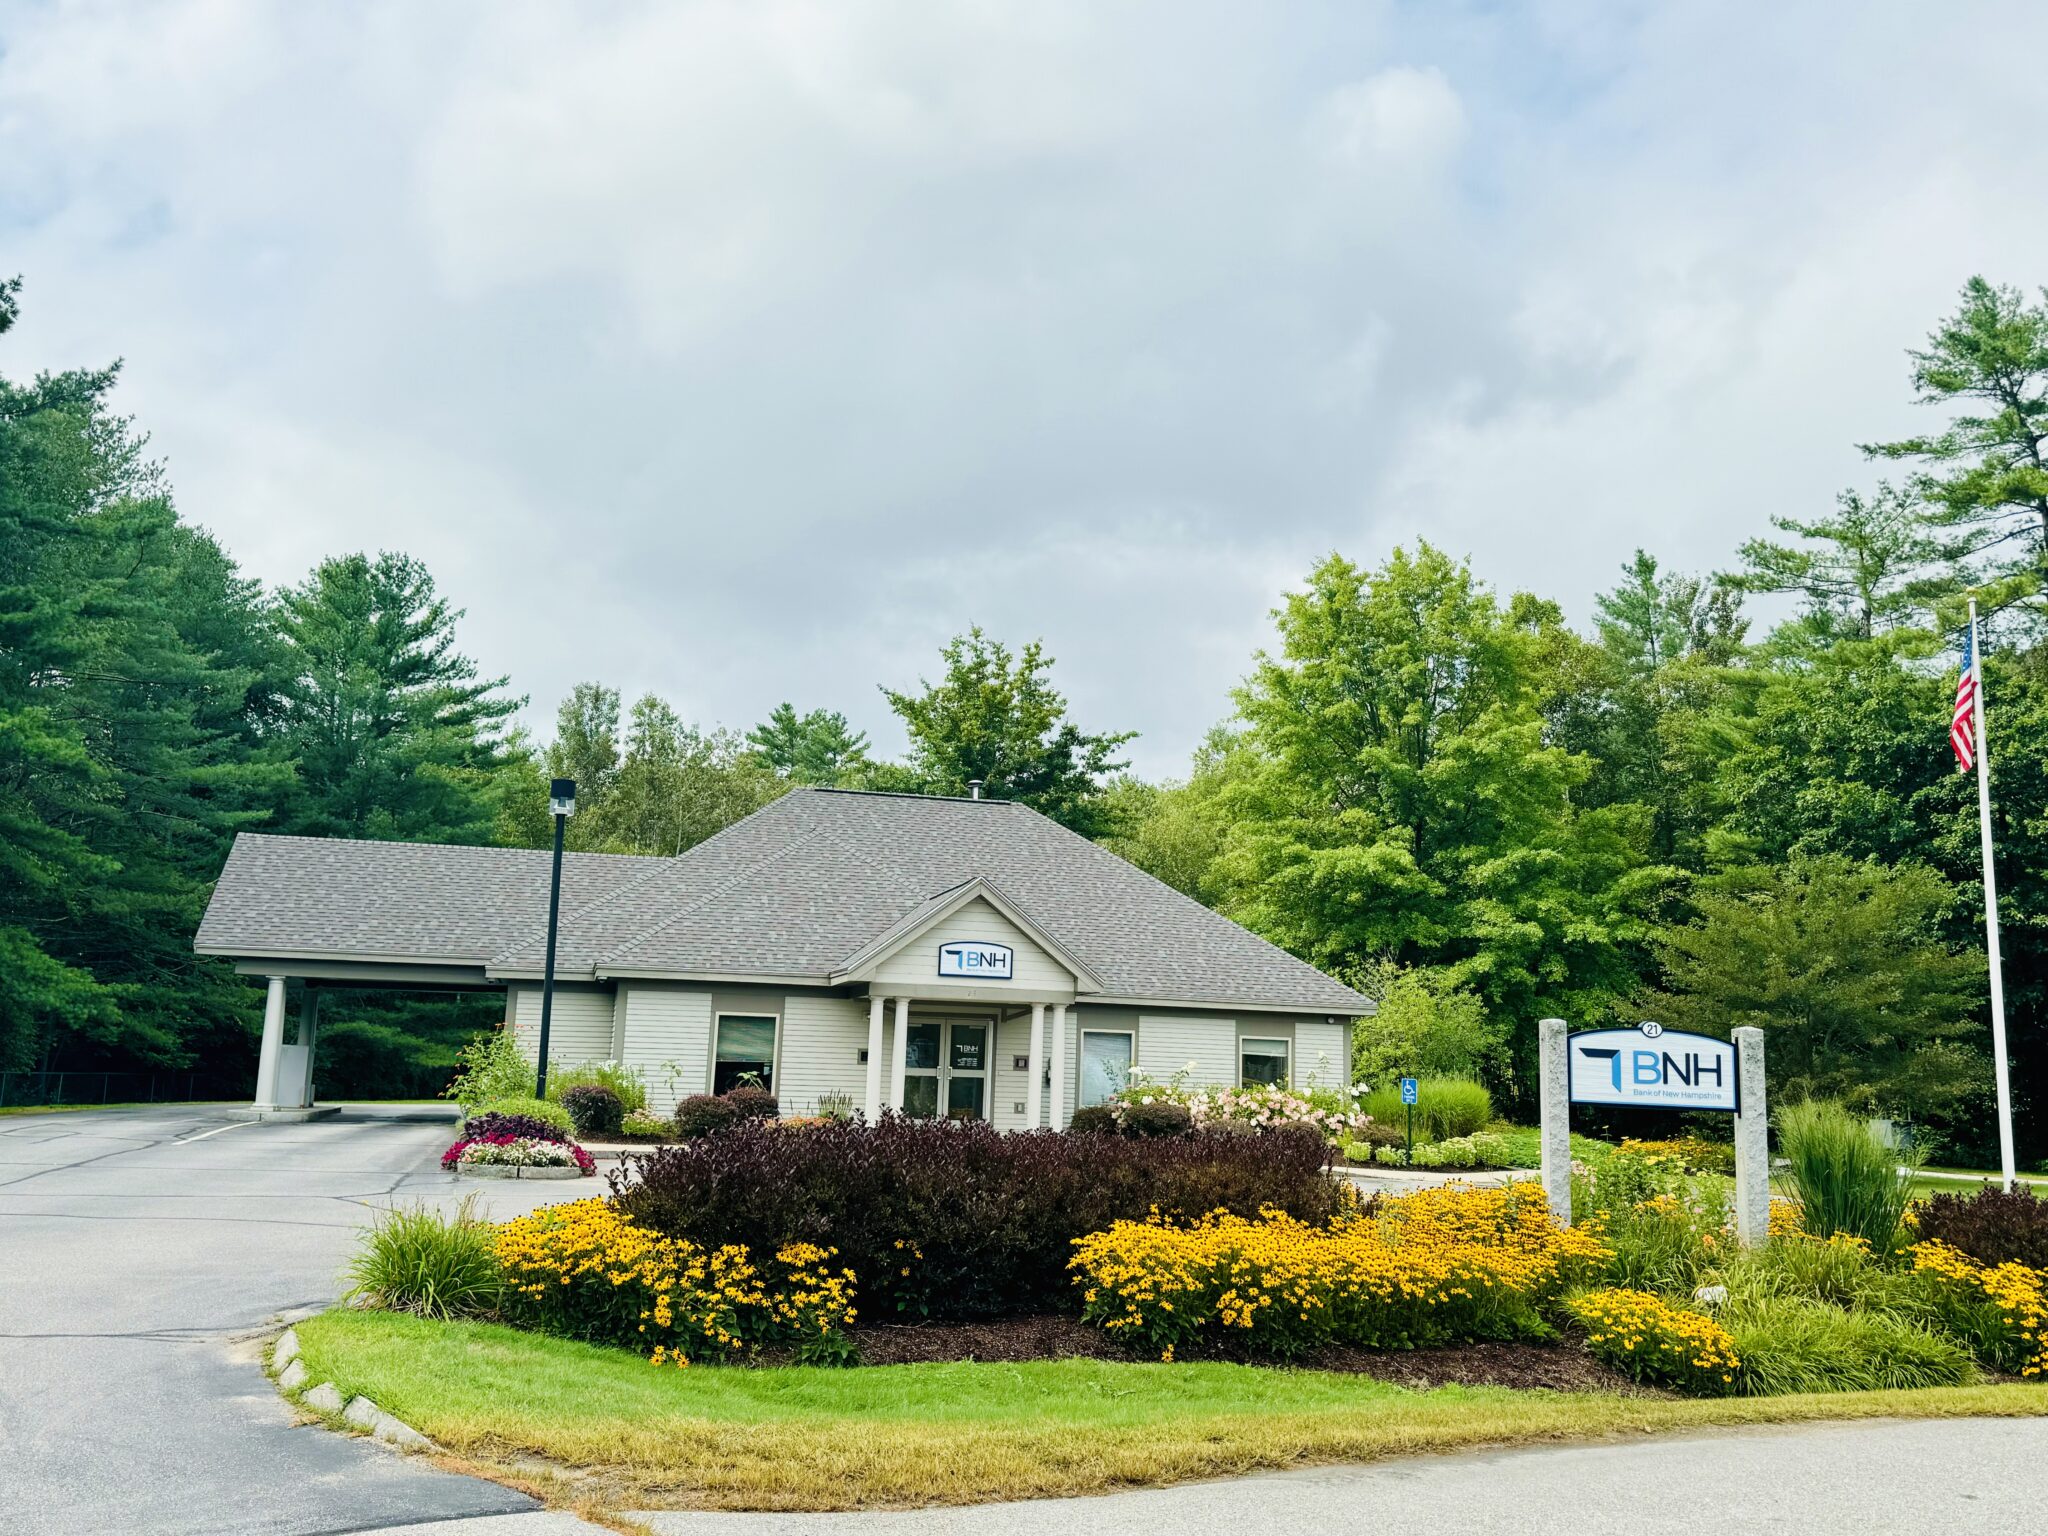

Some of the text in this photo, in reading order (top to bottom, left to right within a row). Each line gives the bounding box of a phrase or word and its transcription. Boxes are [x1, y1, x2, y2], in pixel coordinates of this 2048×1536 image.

[967, 951, 1006, 968] BNH
[1647, 1024, 1658, 1035] 21
[1633, 1050, 1722, 1087] BNH
[1633, 1088, 1653, 1096] Bank
[1662, 1090, 1680, 1098] New
[1681, 1091, 1722, 1100] Hampshire
